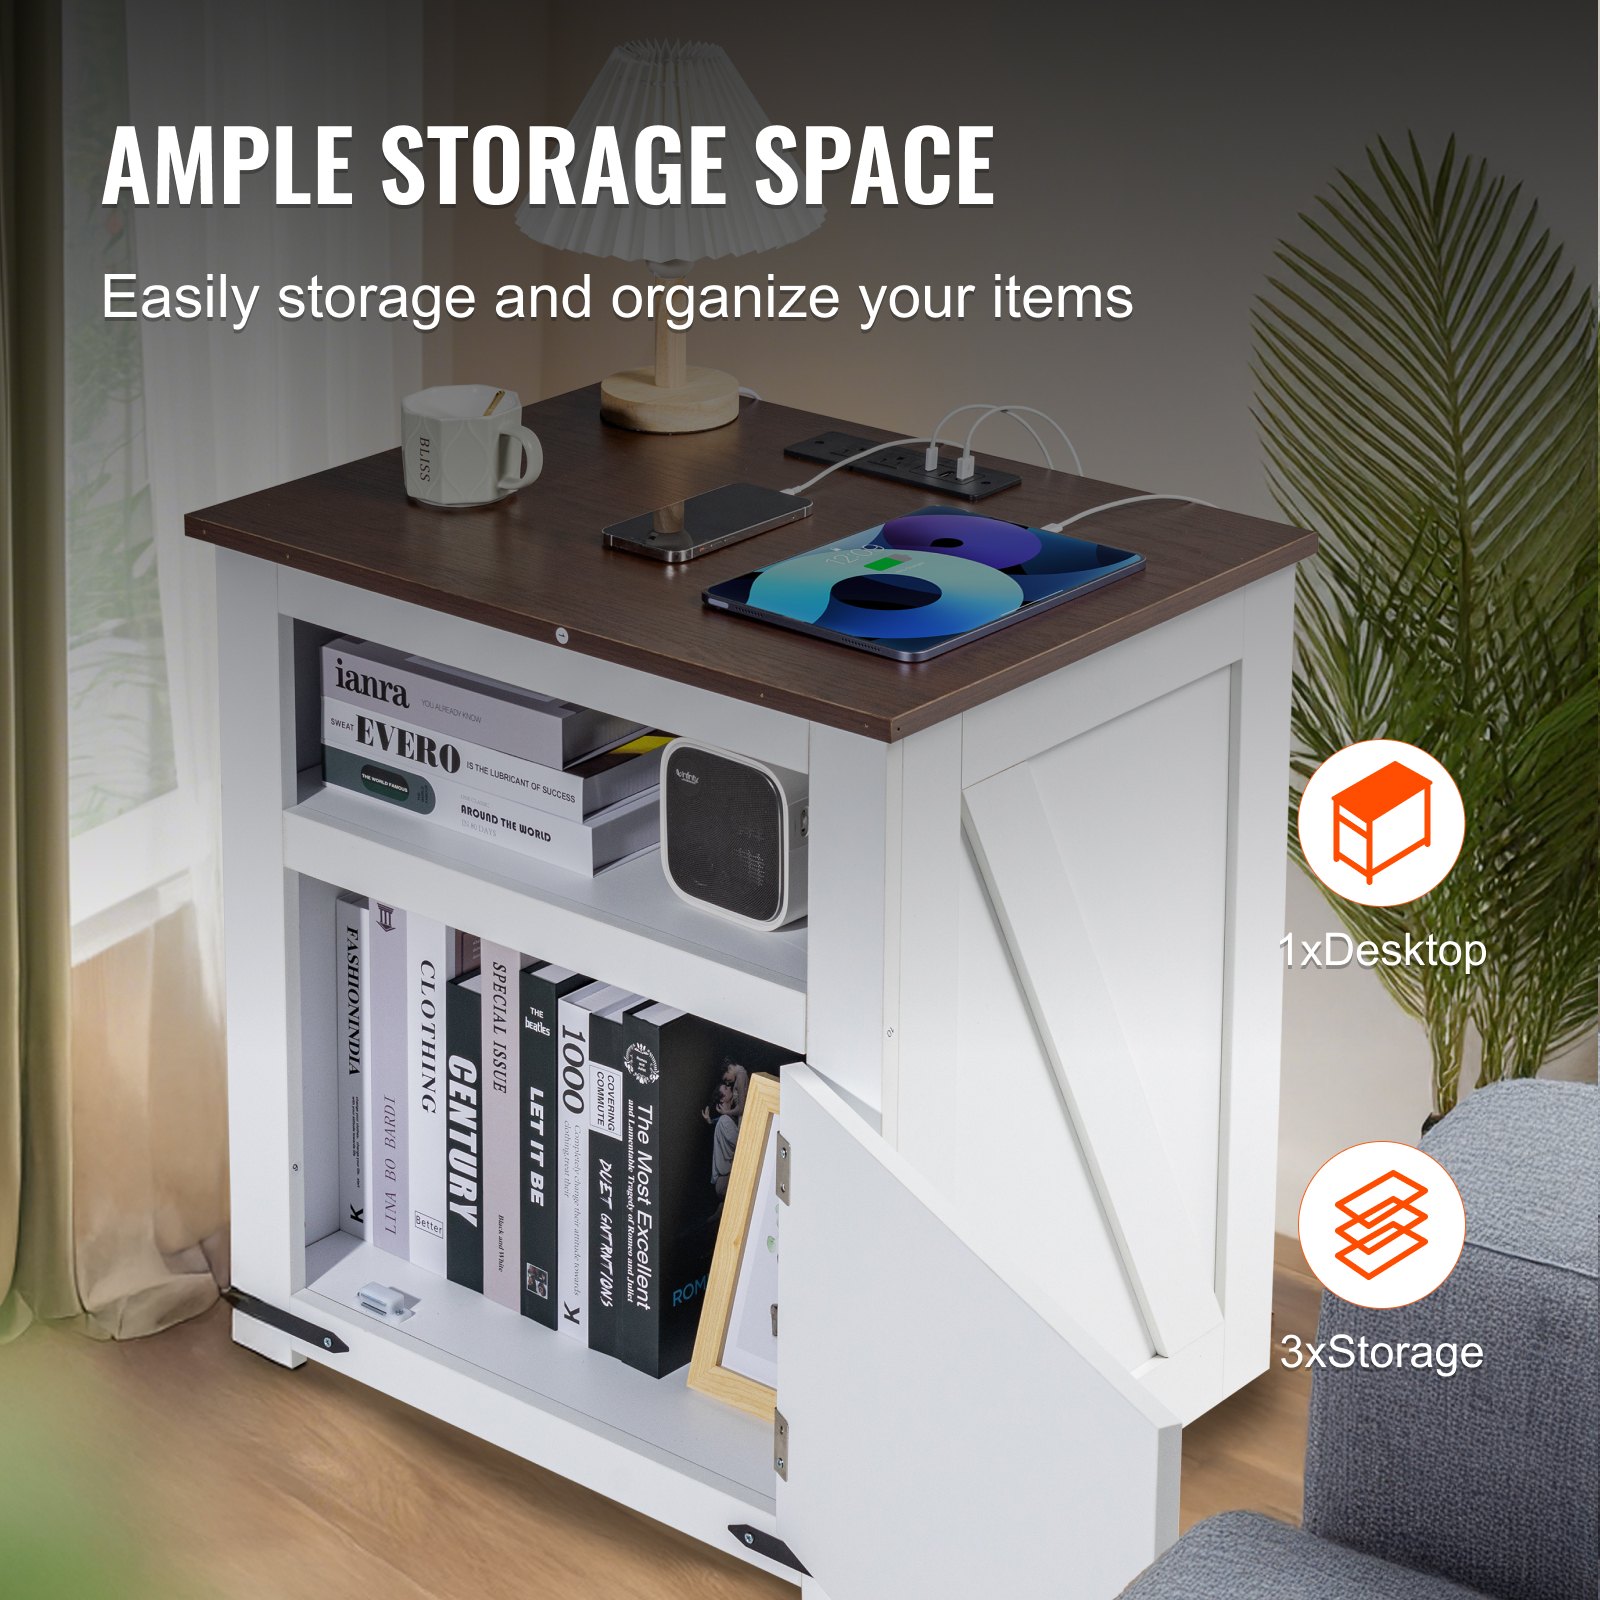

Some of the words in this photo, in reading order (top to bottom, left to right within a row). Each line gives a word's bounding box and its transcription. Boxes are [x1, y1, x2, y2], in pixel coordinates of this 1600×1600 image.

[420, 436, 431, 482] BLISS
[335, 657, 410, 709] ianra
[421, 698, 435, 709] YOU
[434, 704, 462, 718] ALREADY
[461, 711, 482, 724] KNOW
[330, 717, 354, 732] SWEAT
[355, 714, 461, 774] EVERO
[466, 761, 474, 770] IS
[475, 763, 489, 775] THE
[490, 768, 530, 788] LUBRICANT
[531, 782, 541, 791] OF
[542, 785, 576, 803] SUCCESS
[361, 773, 372, 781] THE
[371, 776, 389, 786] WORLD
[388, 782, 409, 793] FAMOUS
[461, 804, 499, 824] AROUND
[500, 817, 517, 831] THE
[519, 823, 551, 842] WORLD
[347, 926, 361, 1075] FASHIONINDIA
[493, 961, 507, 1035] SPECIAL
[530, 1006, 544, 1018] THE
[420, 959, 437, 1114] CLOTHING
[525, 1016, 551, 1037] beatles
[493, 1040, 507, 1094] ISSUE
[562, 1025, 586, 1115] 1000
[530, 1086, 544, 1136] LET
[596, 1071, 605, 1126] COMMUTE
[607, 1075, 615, 1131] COVERING
[384, 1094, 396, 1149] BARDI
[448, 1054, 478, 1228] CENTURY
[637, 1105, 653, 1145] The
[530, 1140, 544, 1168] IT
[573, 1124, 581, 1175] Completely
[627, 1119, 635, 1173] Lamentable
[384, 1158, 397, 1182] BO
[530, 1170, 544, 1207] BE
[564, 1178, 572, 1199] their
[637, 1150, 653, 1205] Most
[572, 1175, 581, 1206] change
[626, 1175, 635, 1212] Tragedy
[350, 1203, 364, 1224] K
[384, 1191, 397, 1235] LINA
[415, 1215, 443, 1234] Better
[573, 1207, 581, 1227] their
[627, 1213, 635, 1225] of
[573, 1228, 581, 1261] attitude
[627, 1225, 635, 1257] Romeo
[636, 1210, 653, 1311] Excellent
[573, 1262, 581, 1296] towards
[563, 1301, 581, 1325] K
